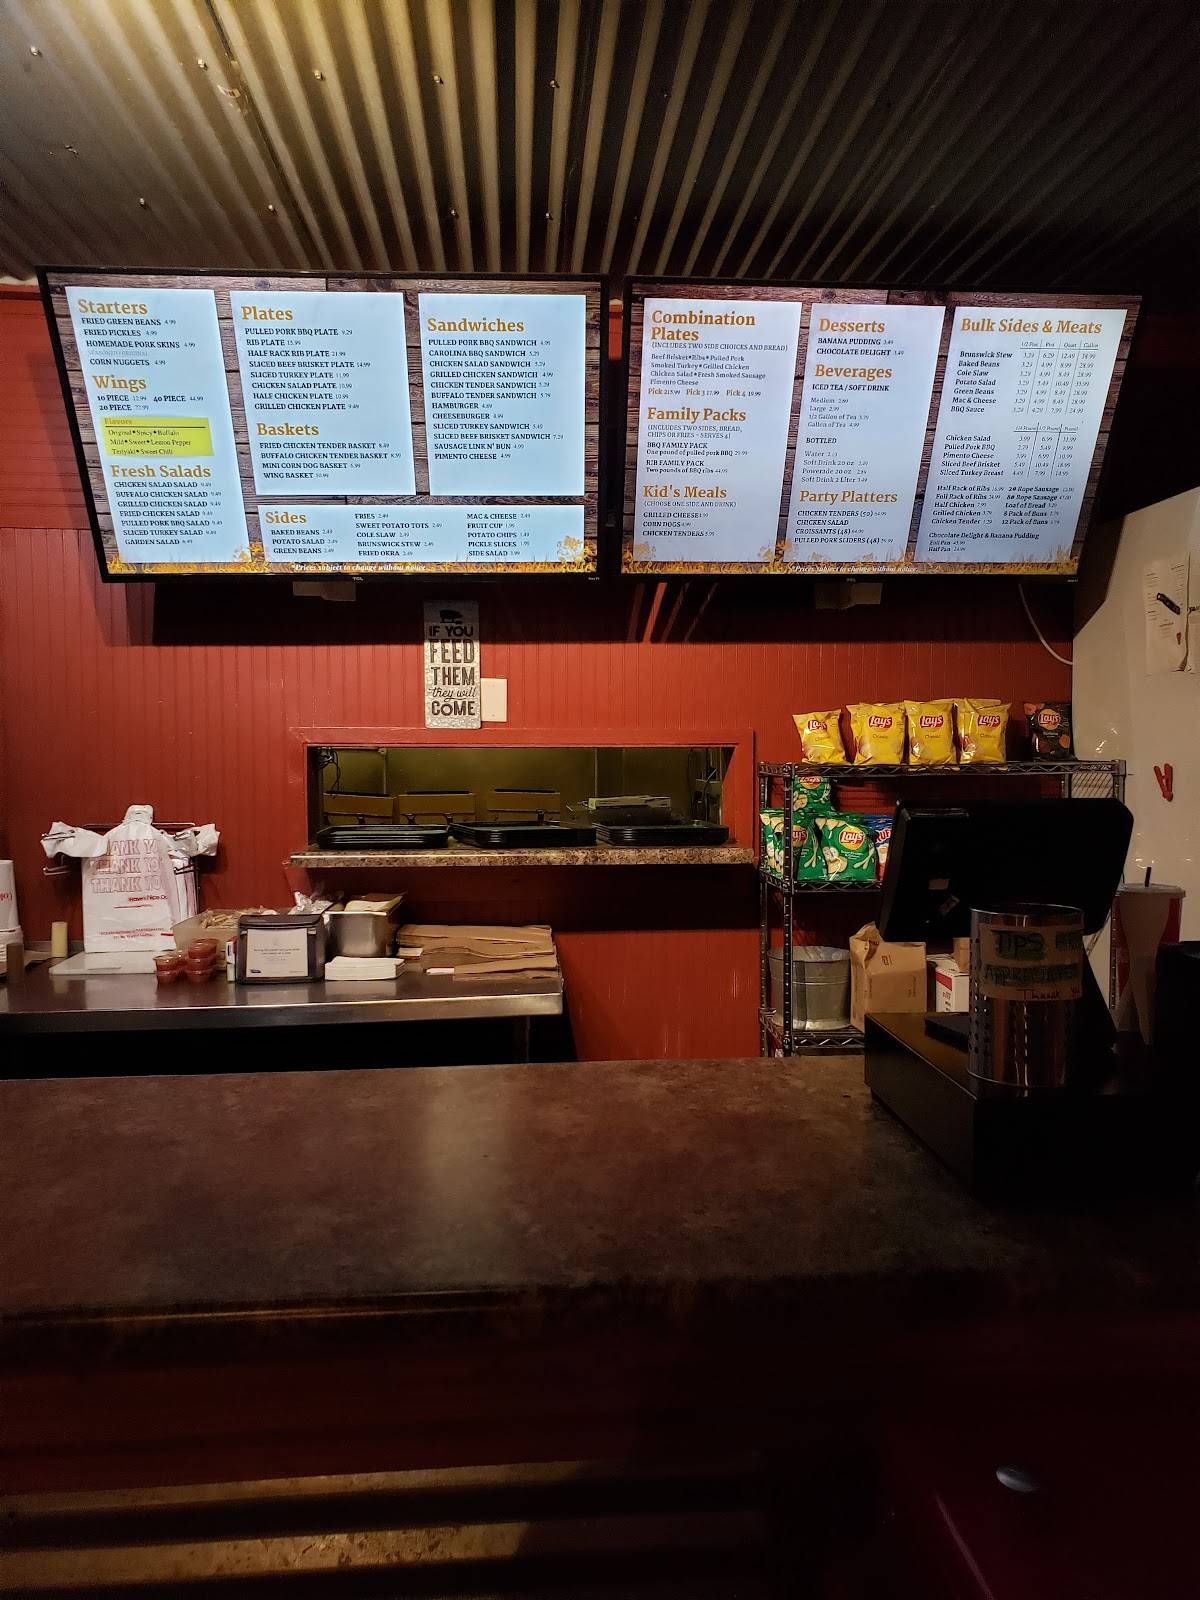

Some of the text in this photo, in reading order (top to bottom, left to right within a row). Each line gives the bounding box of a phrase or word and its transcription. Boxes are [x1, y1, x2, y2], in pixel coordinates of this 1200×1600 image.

[77, 299, 148, 315] Starters
[240, 306, 293, 320] Plates
[426, 318, 524, 332] Sandwiches
[651, 310, 755, 326] Combination
[960, 317, 1102, 333] Bulk Sides & Meats
[650, 326, 699, 340] Plates
[818, 319, 885, 333] Desserts
[133, 340, 155, 348] PORK
[816, 347, 890, 356] CHOCOLATE DELIGHT
[959, 350, 995, 358] Brunswick
[815, 364, 892, 381] Beverages
[92, 375, 147, 392] Wings
[844, 383, 848, 391] /
[647, 406, 746, 424] Family Packs
[256, 422, 319, 435] Baskets
[109, 464, 211, 477] Fresh Salads
[642, 484, 726, 498] Kid's Meals
[798, 490, 898, 505] Party Platters
[264, 511, 307, 523] Sides
[859, 509, 874, 517] (50)
[429, 626, 474, 636] IF YOU
[429, 639, 474, 663] FEED
[431, 667, 475, 685] THEM
[429, 687, 477, 702] they will
[432, 701, 475, 716] COME
[90, 876, 142, 894] THANK
